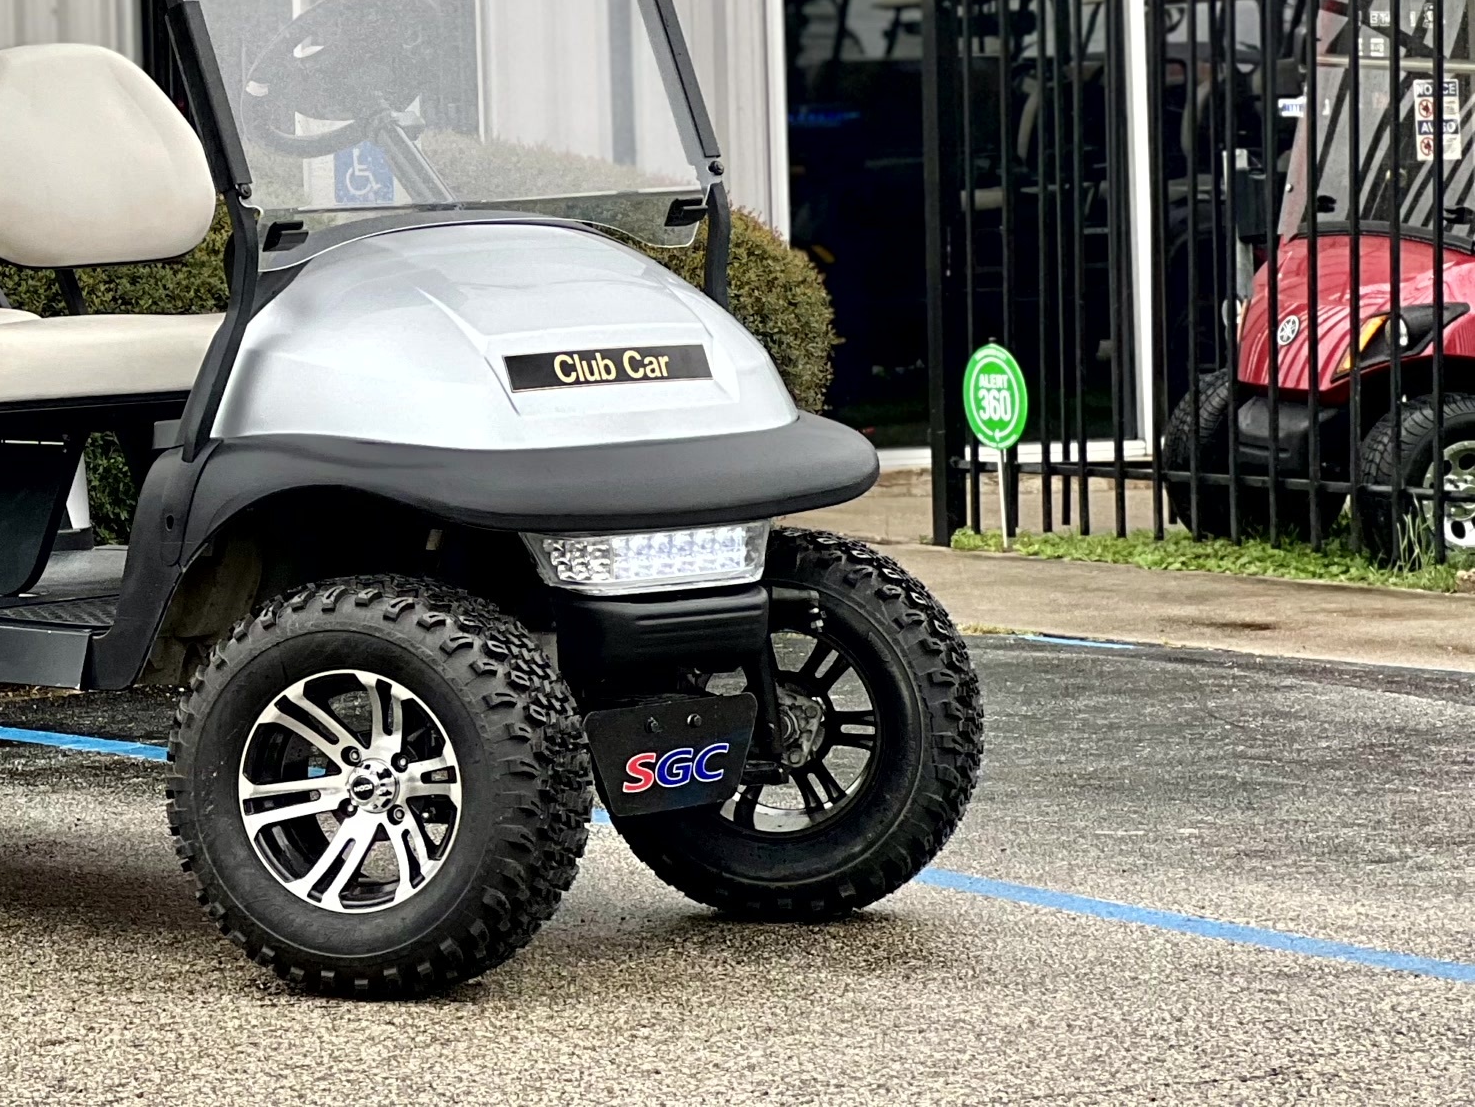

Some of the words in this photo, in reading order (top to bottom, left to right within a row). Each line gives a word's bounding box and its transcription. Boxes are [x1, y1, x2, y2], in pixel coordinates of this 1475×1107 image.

[1416, 83, 1456, 95] NOCE
[1421, 121, 1456, 133] AVSO
[553, 353, 617, 384] Club
[622, 350, 669, 379] Car
[978, 374, 1008, 389] ALERT
[978, 389, 1012, 422] 360
[622, 743, 730, 793] SGC
